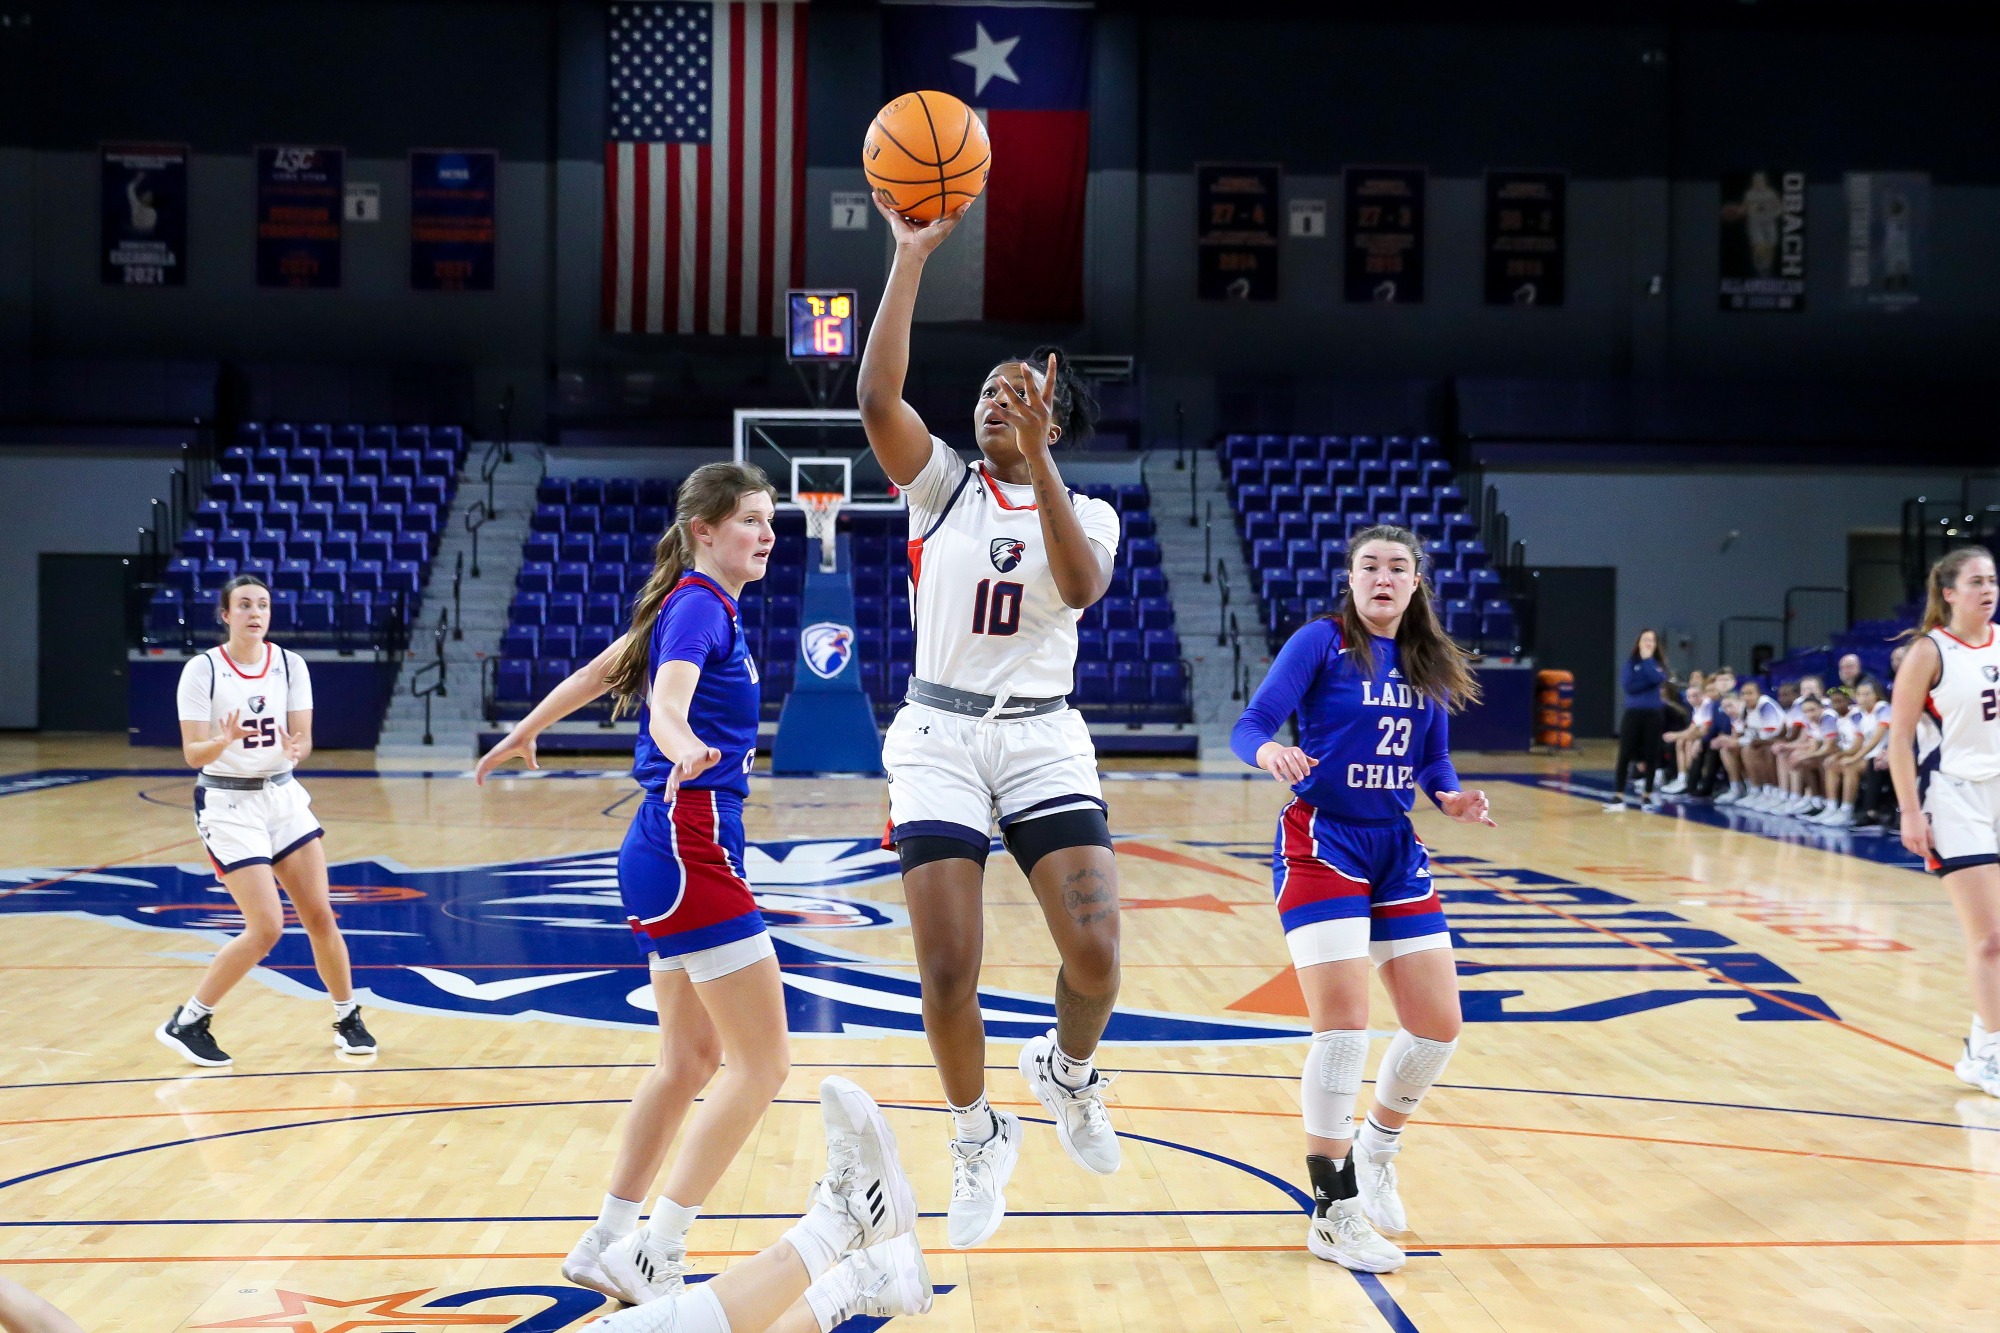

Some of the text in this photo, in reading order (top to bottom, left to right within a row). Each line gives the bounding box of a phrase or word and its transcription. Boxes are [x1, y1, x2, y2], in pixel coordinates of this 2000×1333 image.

[845, 207, 854, 226] 7
[807, 296, 850, 318] 7:18
[814, 317, 844, 354] 16
[972, 578, 1024, 636] 10
[1362, 681, 1425, 710] LADY
[1981, 689, 2000, 721] 2
[242, 717, 276, 749] 25
[1376, 716, 1413, 757] 23
